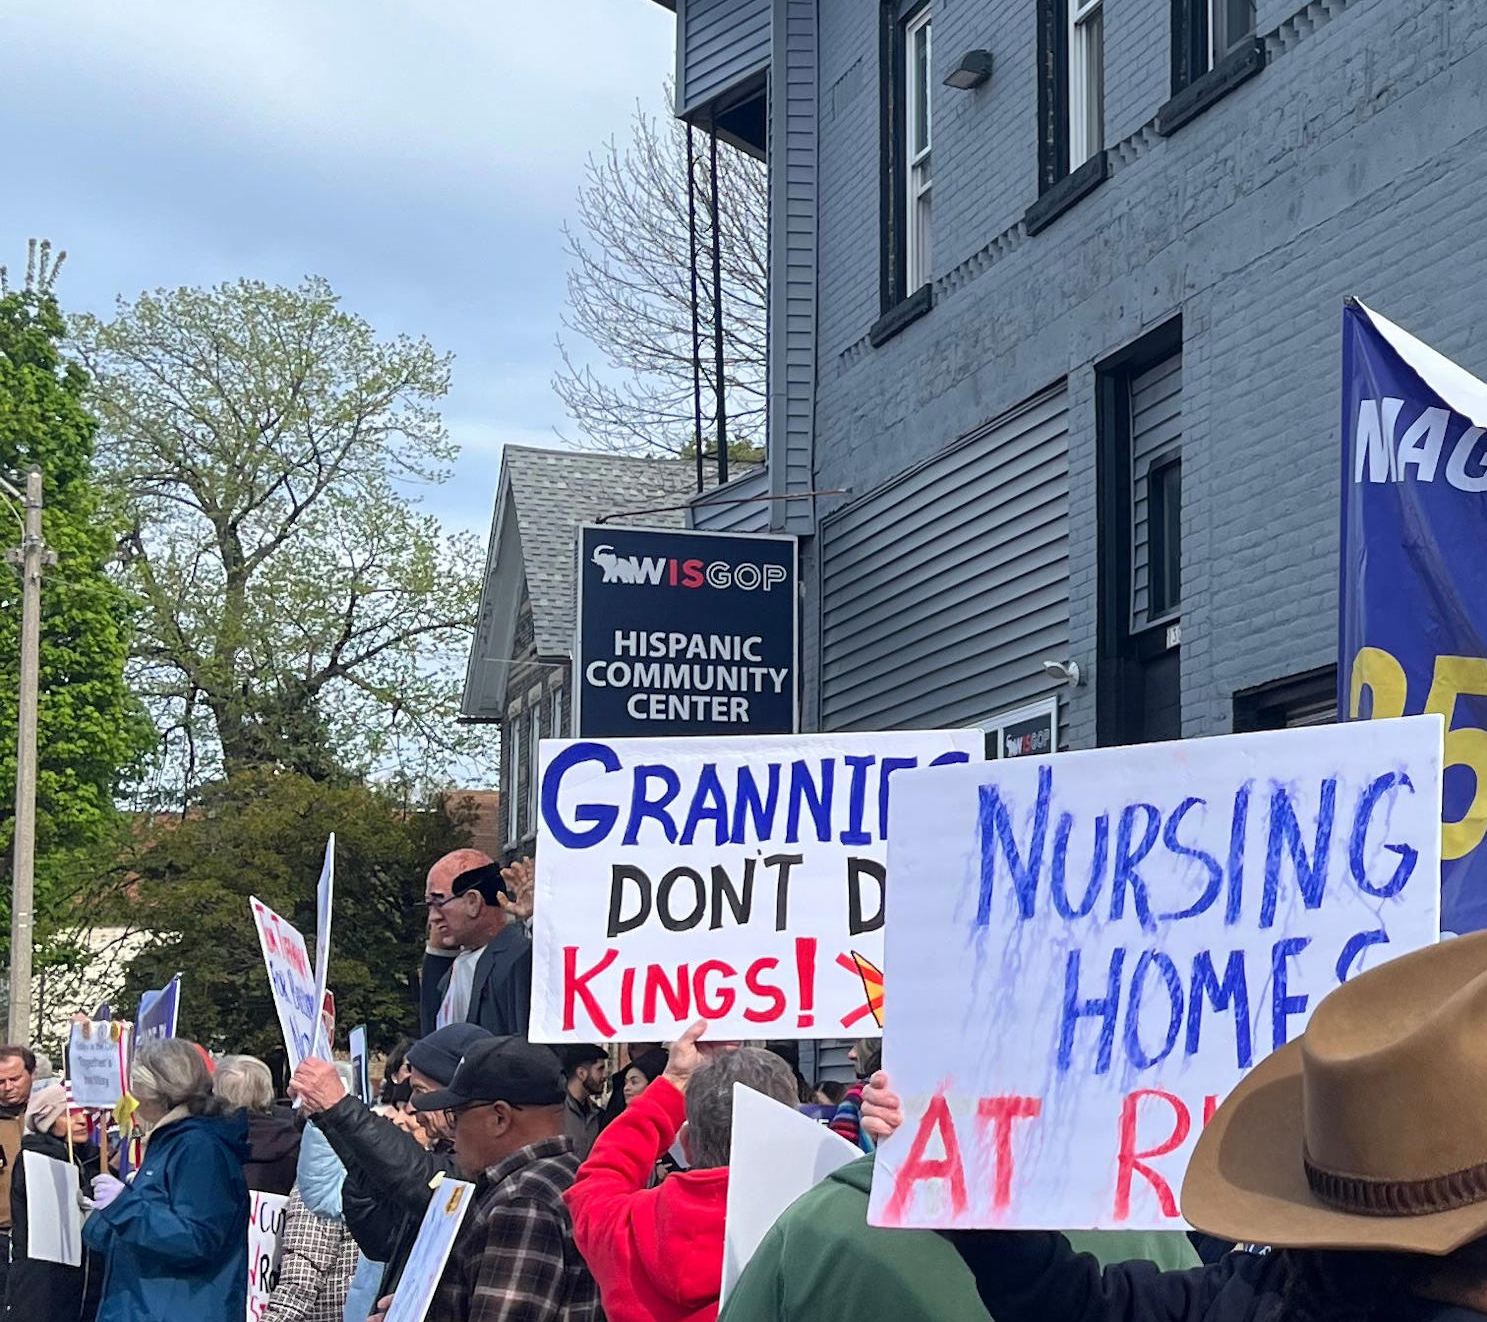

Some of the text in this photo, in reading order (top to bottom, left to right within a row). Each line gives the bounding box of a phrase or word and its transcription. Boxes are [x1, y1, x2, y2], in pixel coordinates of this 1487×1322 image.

[628, 556, 787, 592] WISGOP
[586, 660, 789, 694] COMMUNITY
[614, 630, 763, 662] HISPANIC
[627, 693, 750, 723] CENTER
[976, 765, 1419, 930] NURSING
[606, 849, 803, 938] DON'T
[561, 938, 818, 1038] KINGS!
[883, 1096, 1042, 1224] AT
